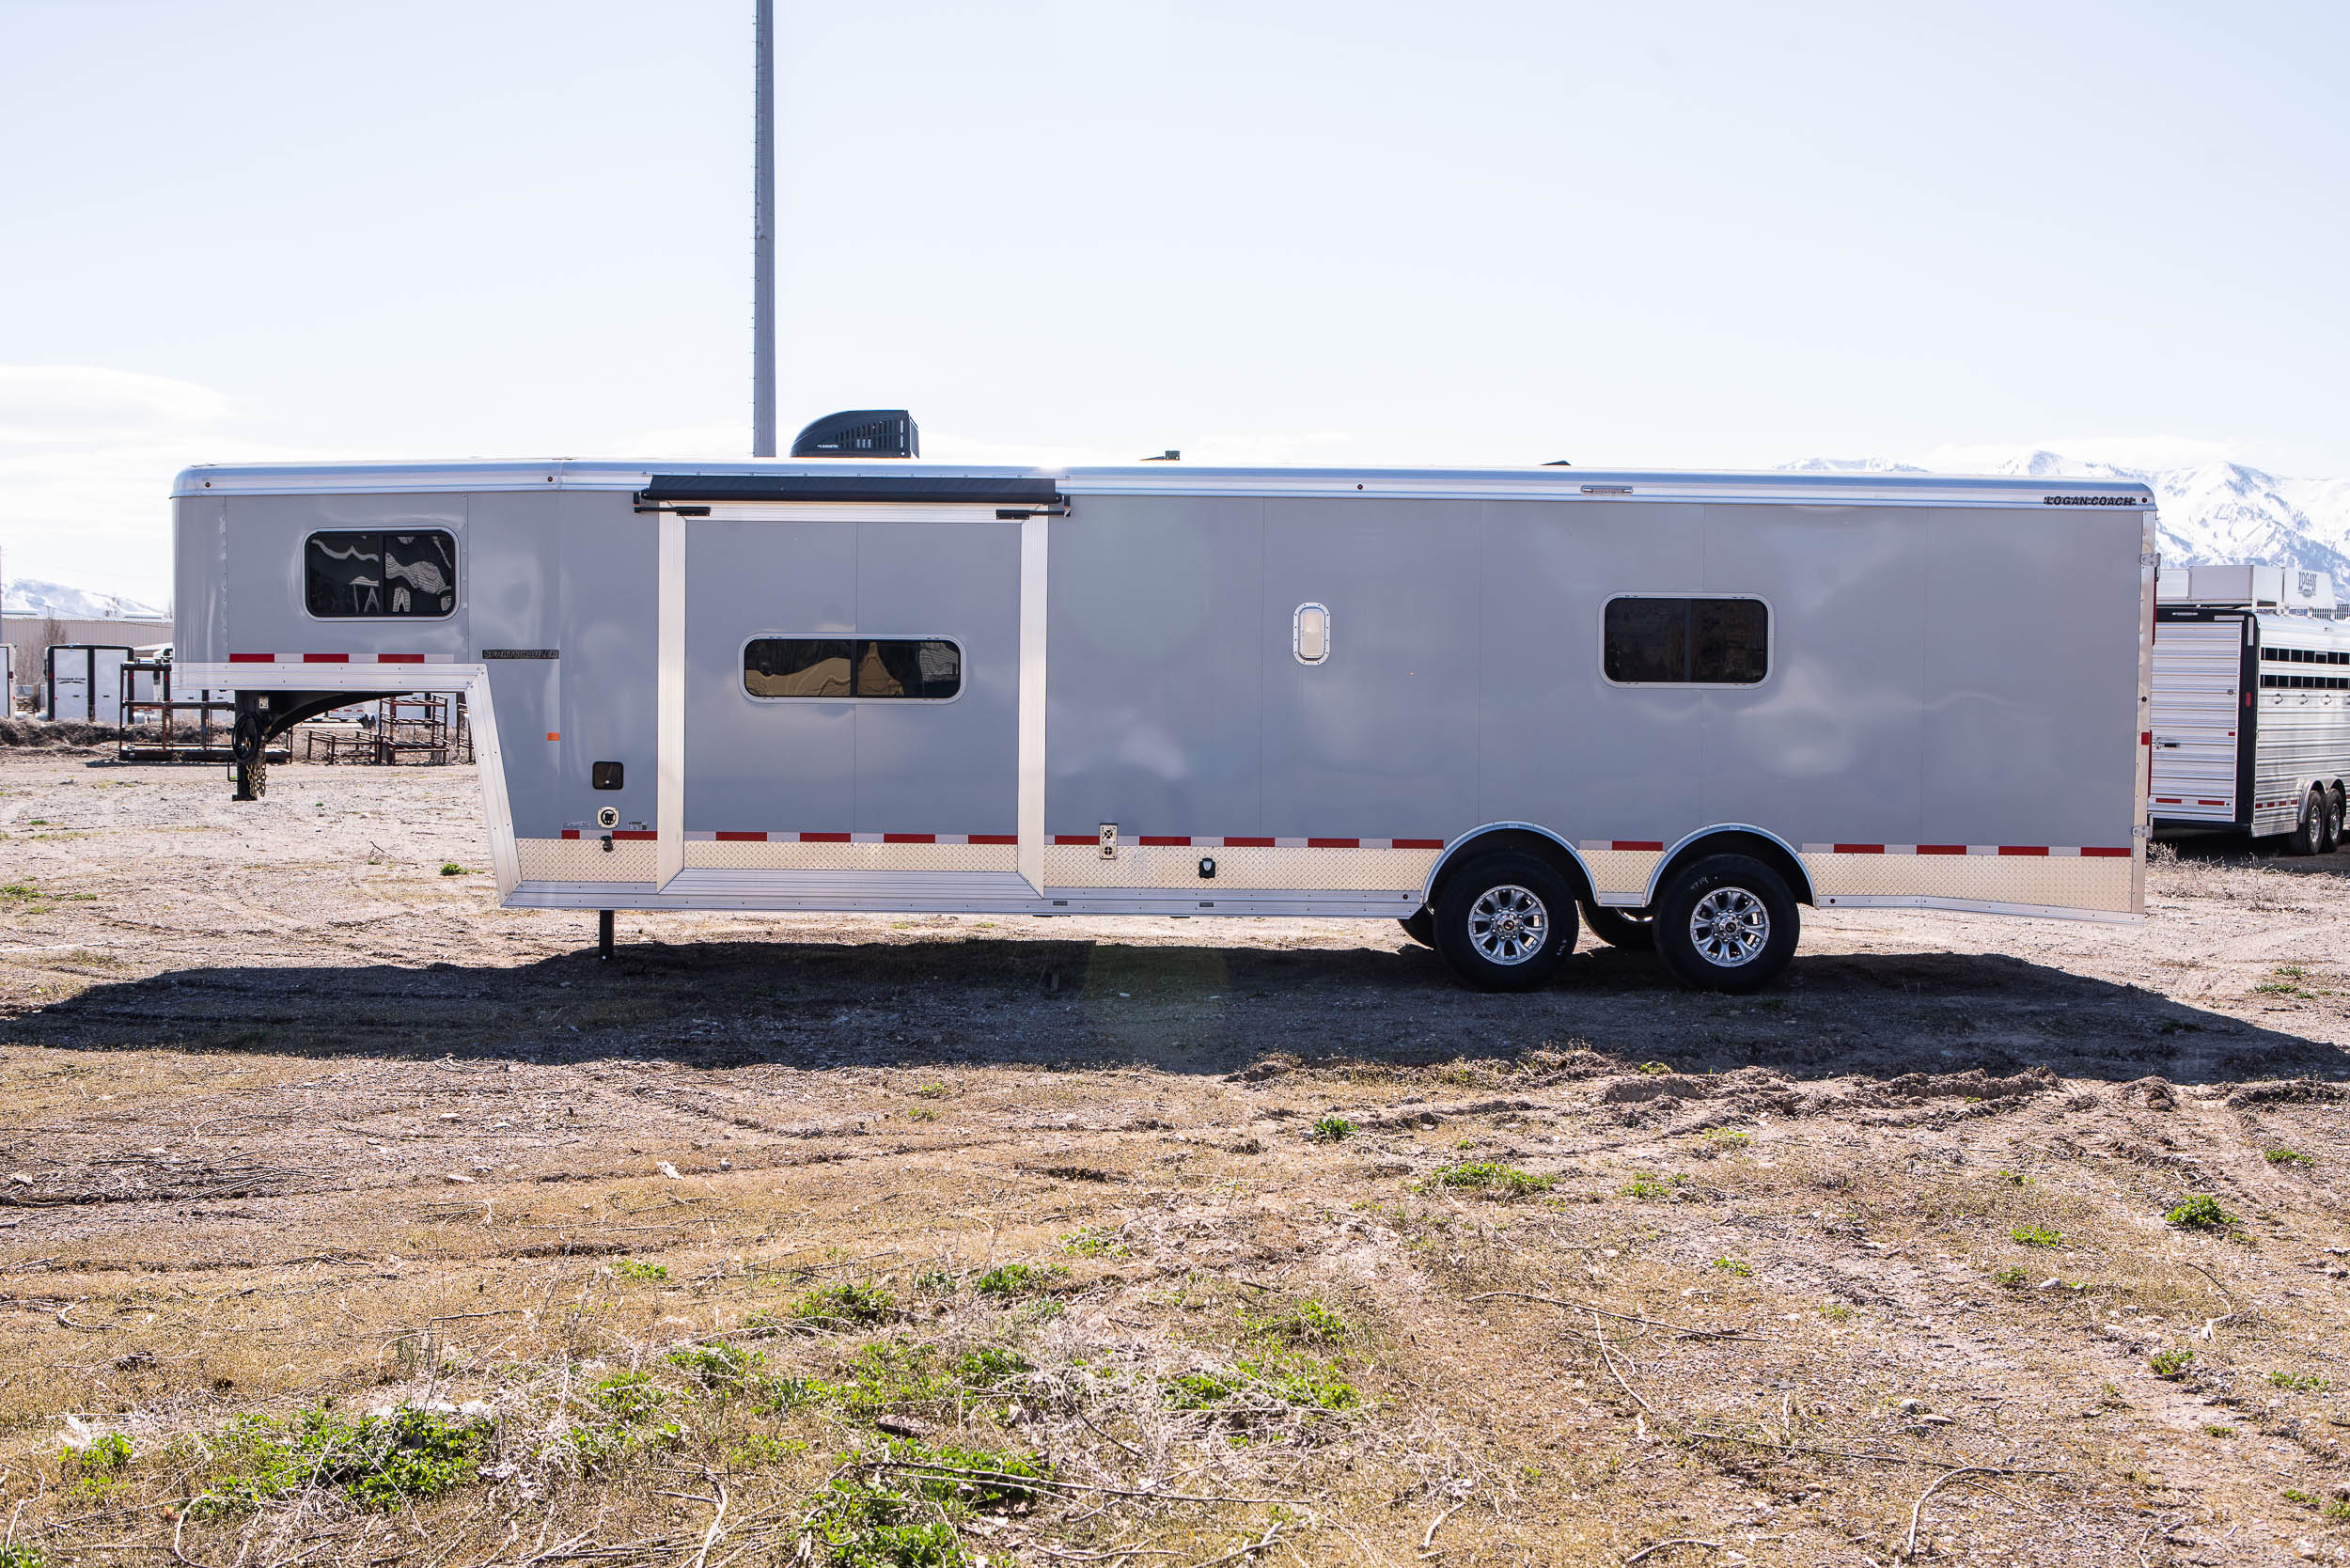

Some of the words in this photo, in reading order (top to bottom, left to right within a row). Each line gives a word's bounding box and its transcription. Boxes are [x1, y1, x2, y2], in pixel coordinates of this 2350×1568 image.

[2045, 496, 2088, 506] LOGAN
[2090, 496, 2135, 507] COACH
[2298, 572, 2317, 591] LOGAN
